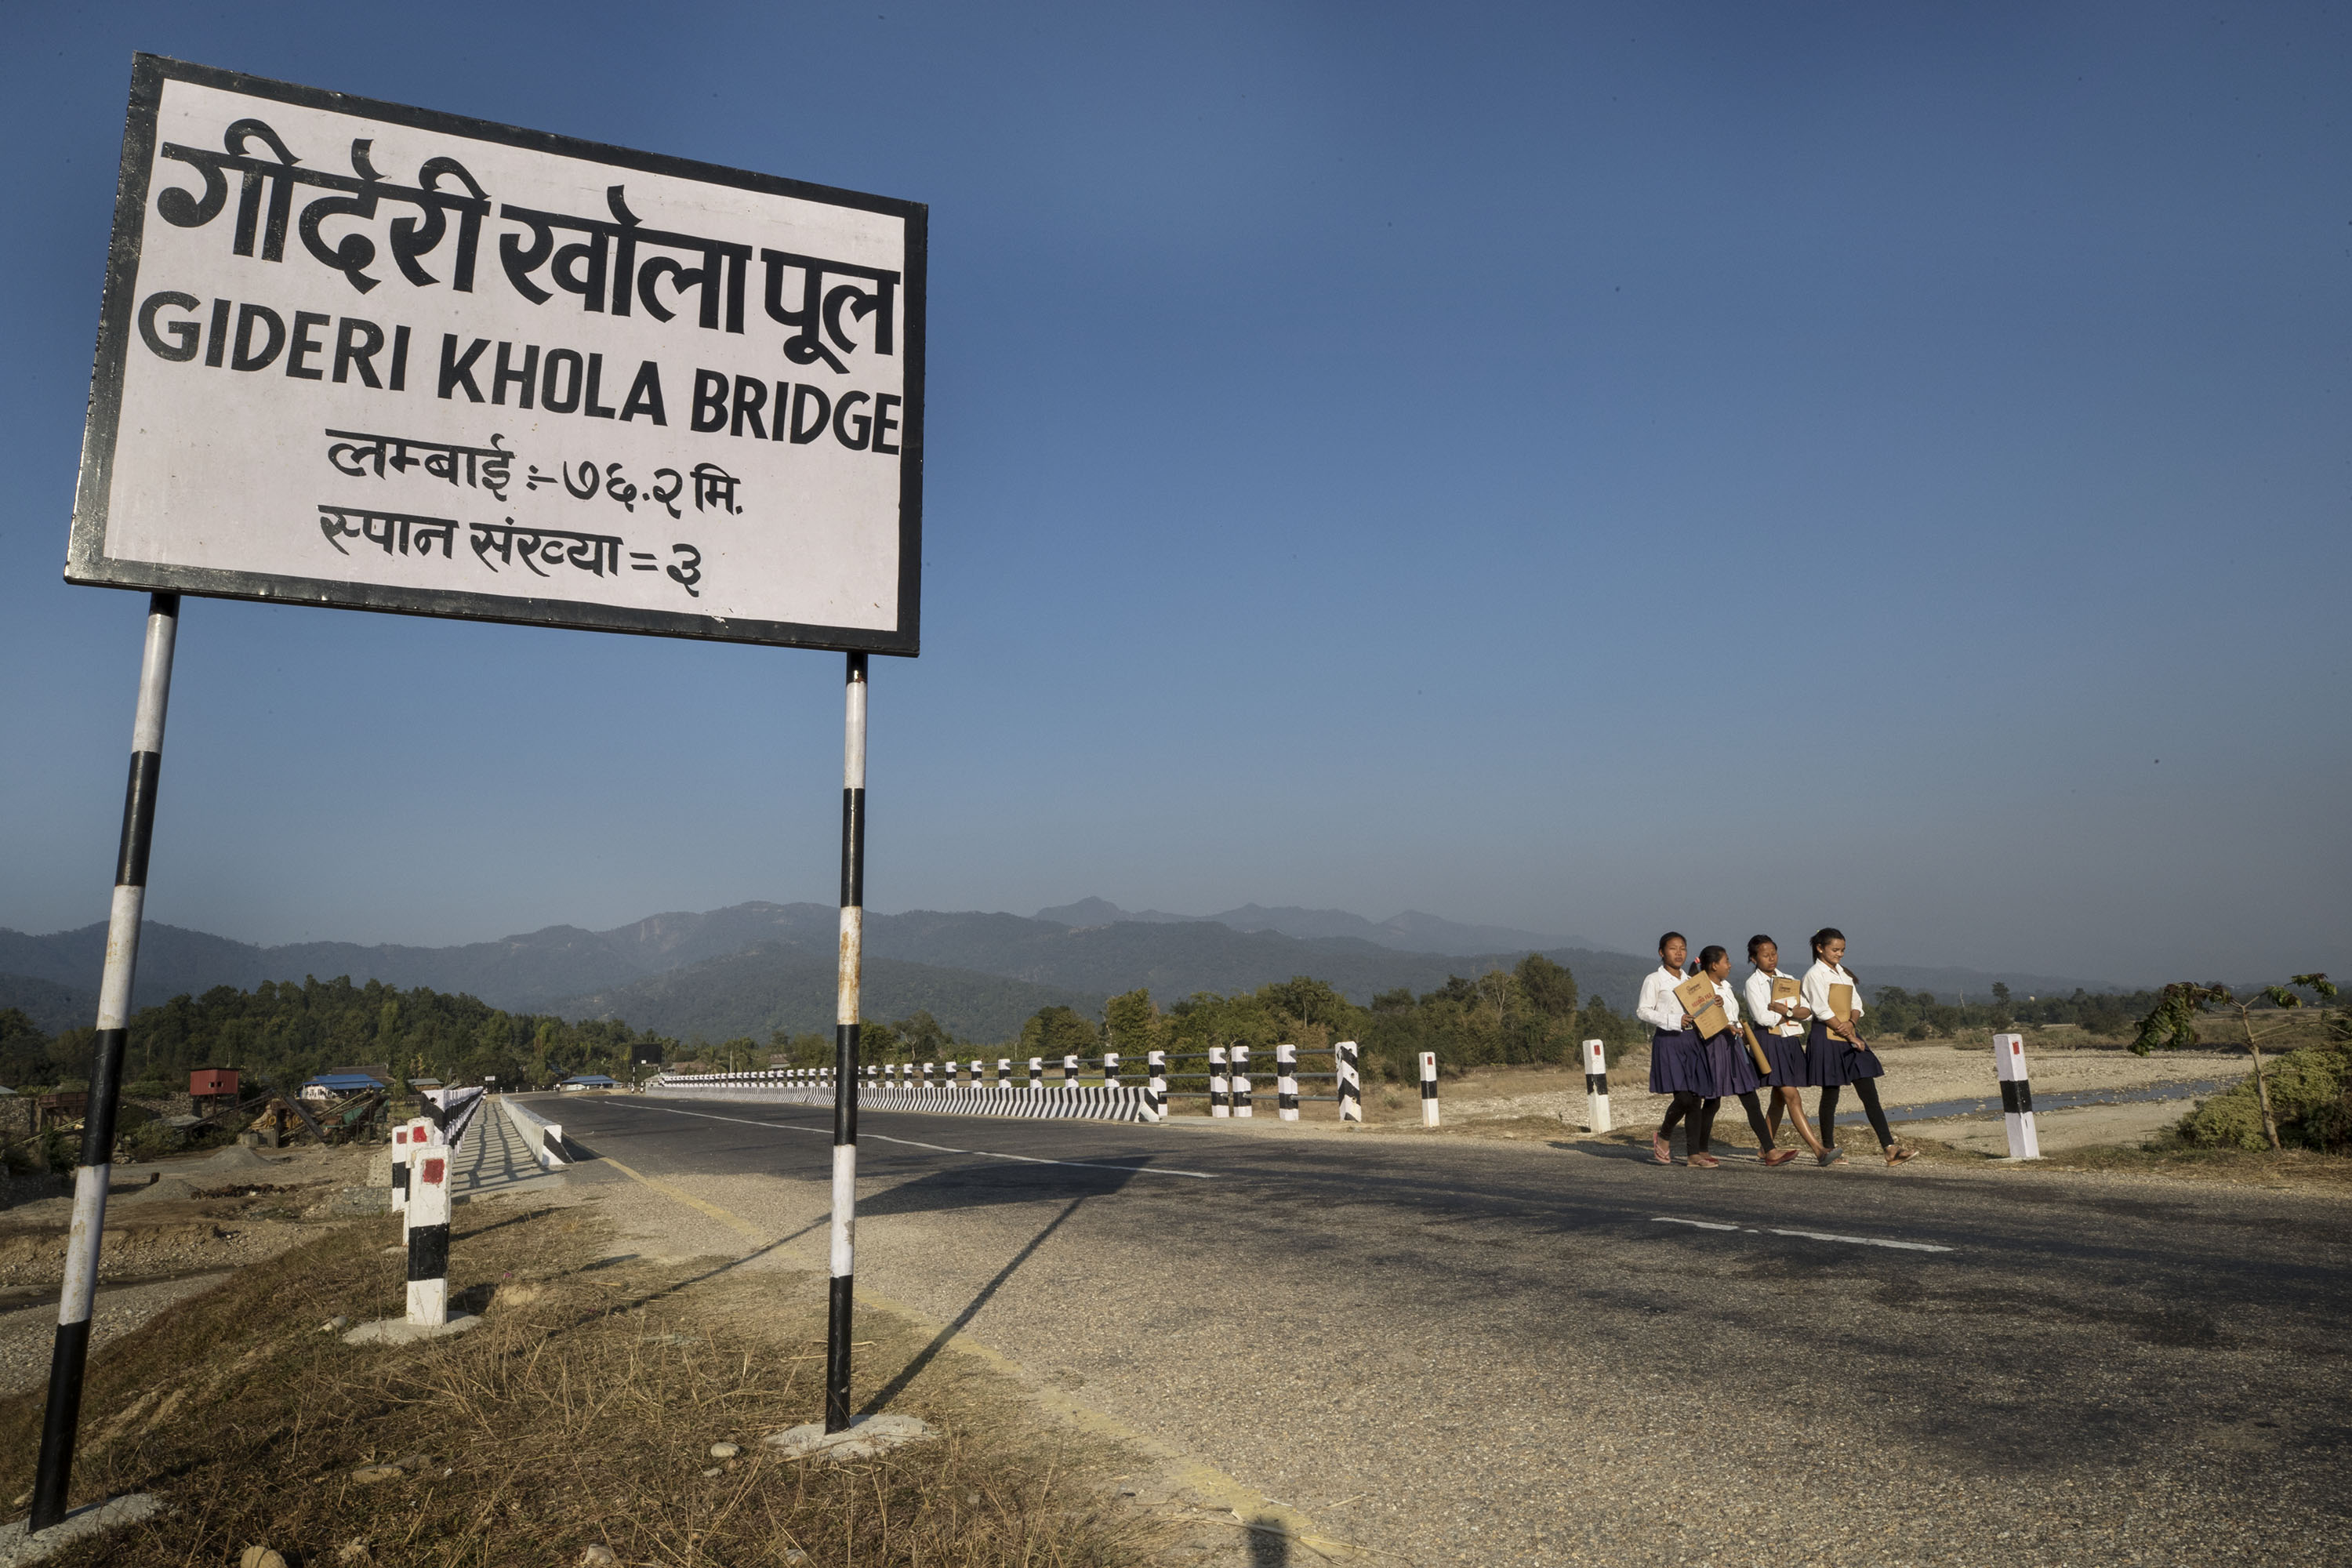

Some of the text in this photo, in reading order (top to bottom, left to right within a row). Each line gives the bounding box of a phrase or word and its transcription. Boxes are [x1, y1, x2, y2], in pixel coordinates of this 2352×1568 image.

[137, 290, 902, 456] GIDERI KHOLA BRIDGE
[317, 504, 460, 560] स्पान
